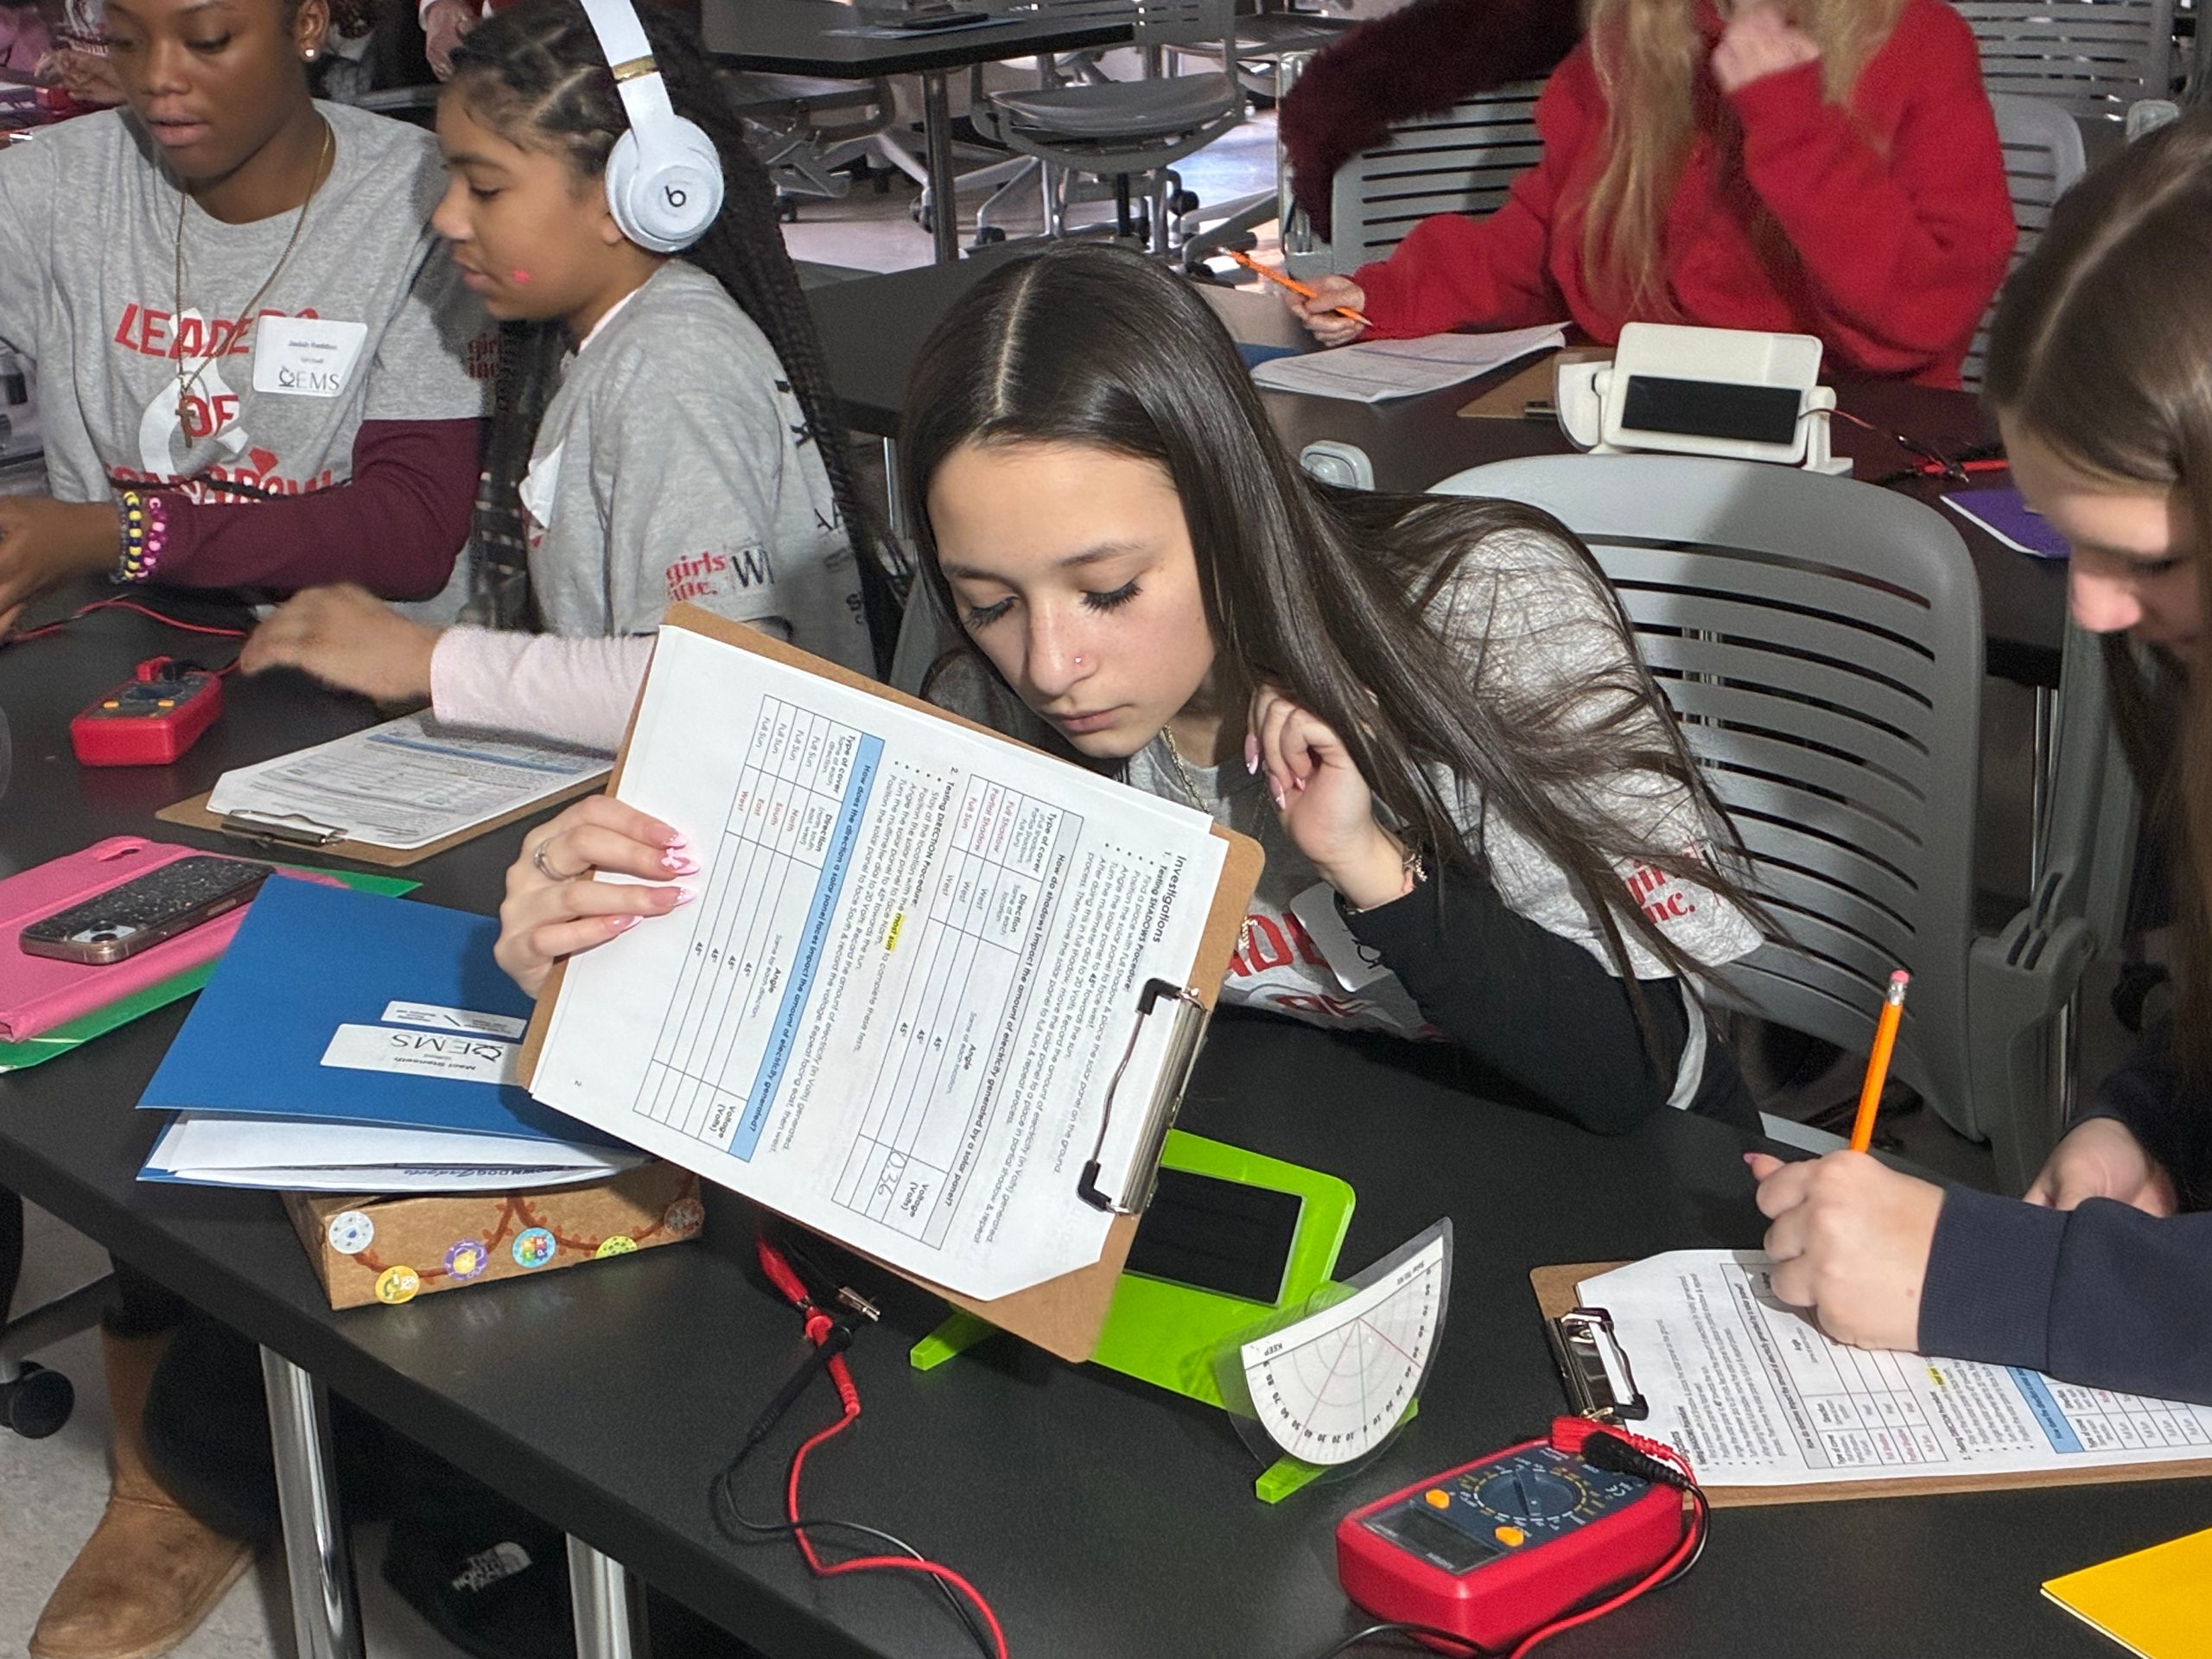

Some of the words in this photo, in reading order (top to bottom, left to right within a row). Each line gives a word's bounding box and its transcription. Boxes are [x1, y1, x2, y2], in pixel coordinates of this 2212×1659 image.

[114, 303, 319, 359] LEADE
[665, 550, 727, 585] girls
[842, 734, 855, 757] Type
[832, 766, 844, 793] cover
[859, 764, 871, 785] How
[852, 785, 865, 808] does
[937, 779, 954, 812] Testing
[815, 812, 832, 853] Direction
[847, 808, 858, 824] the
[1042, 811, 1057, 836] Type
[836, 823, 853, 864] direction
[925, 811, 944, 860] DIRECTION
[1032, 845, 1045, 873] cover
[1052, 853, 1065, 875] How
[826, 871, 839, 894] solar
[1149, 863, 1166, 896] Testing
[817, 893, 832, 921] panel
[1009, 893, 1027, 934] Direction
[1034, 890, 1054, 932] shadows
[1148, 854, 1186, 944] Investigations
[810, 919, 824, 945] faces
[1137, 896, 1157, 943] SHADOWS
[799, 944, 817, 978] impact
[1022, 931, 1041, 967] impact
[766, 966, 781, 995] Angle
[796, 976, 806, 994] the
[1019, 966, 1030, 983] the
[785, 992, 802, 1028] amount
[1007, 982, 1025, 1020] amount
[765, 1037, 787, 1081] electricity
[961, 1042, 976, 1071] Angle
[988, 1030, 1011, 1078] electricity
[708, 1102, 724, 1132] (Volts)
[747, 1079, 772, 1133] generated?
[972, 1077, 996, 1128] generated
[715, 1103, 735, 1140] Voltage
[957, 1149, 972, 1173] solar
[899, 1179, 918, 1211] (Volts)
[906, 1181, 929, 1218] Voltage
[941, 1172, 963, 1207] panel?
